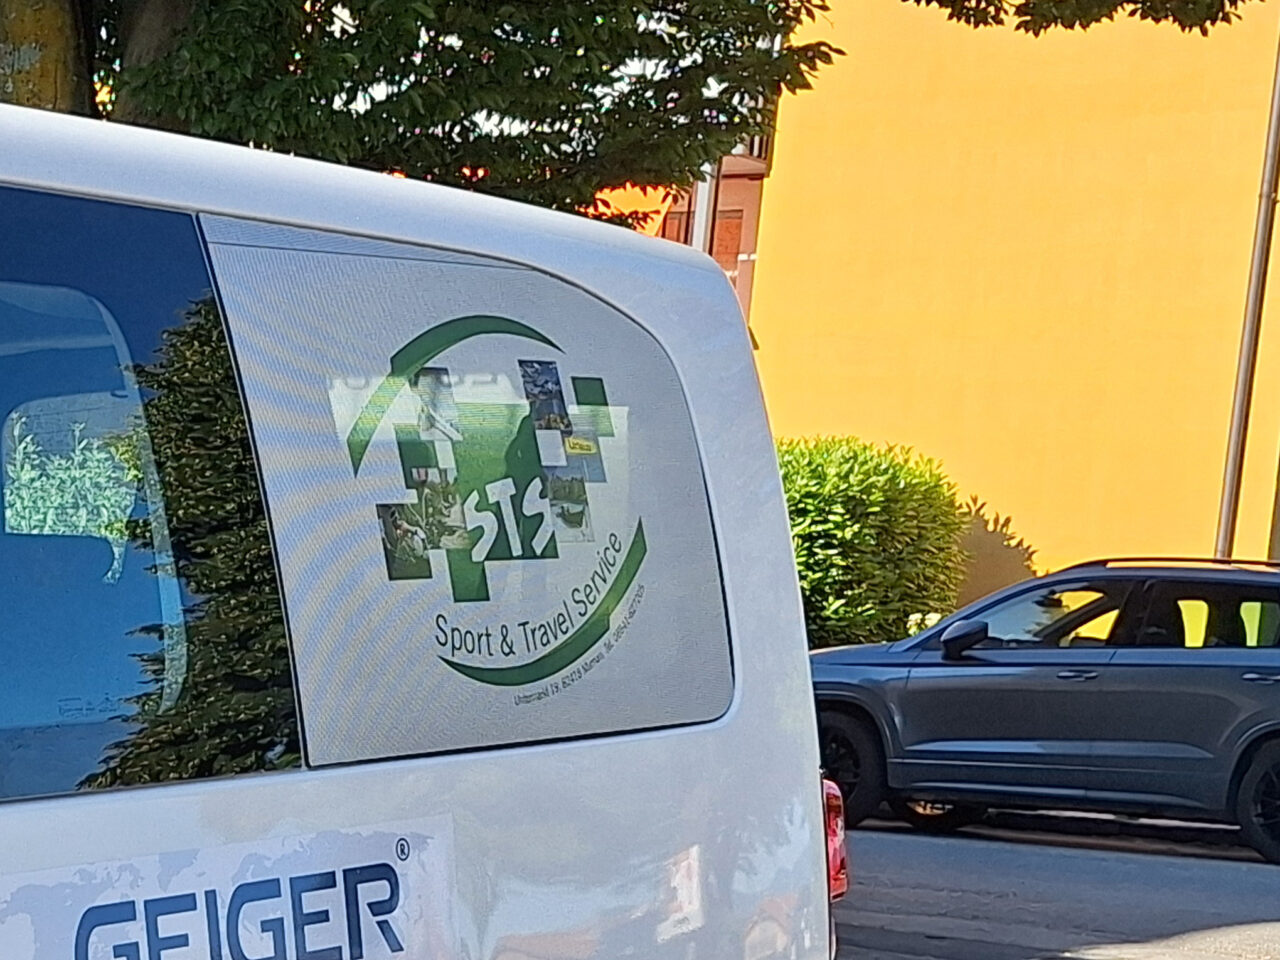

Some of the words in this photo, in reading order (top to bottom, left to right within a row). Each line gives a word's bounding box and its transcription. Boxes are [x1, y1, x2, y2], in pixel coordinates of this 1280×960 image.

[463, 476, 558, 562] STS
[435, 613, 494, 658] Sport
[500, 624, 517, 657] &
[517, 599, 575, 653] Travel
[571, 531, 623, 618] Service
